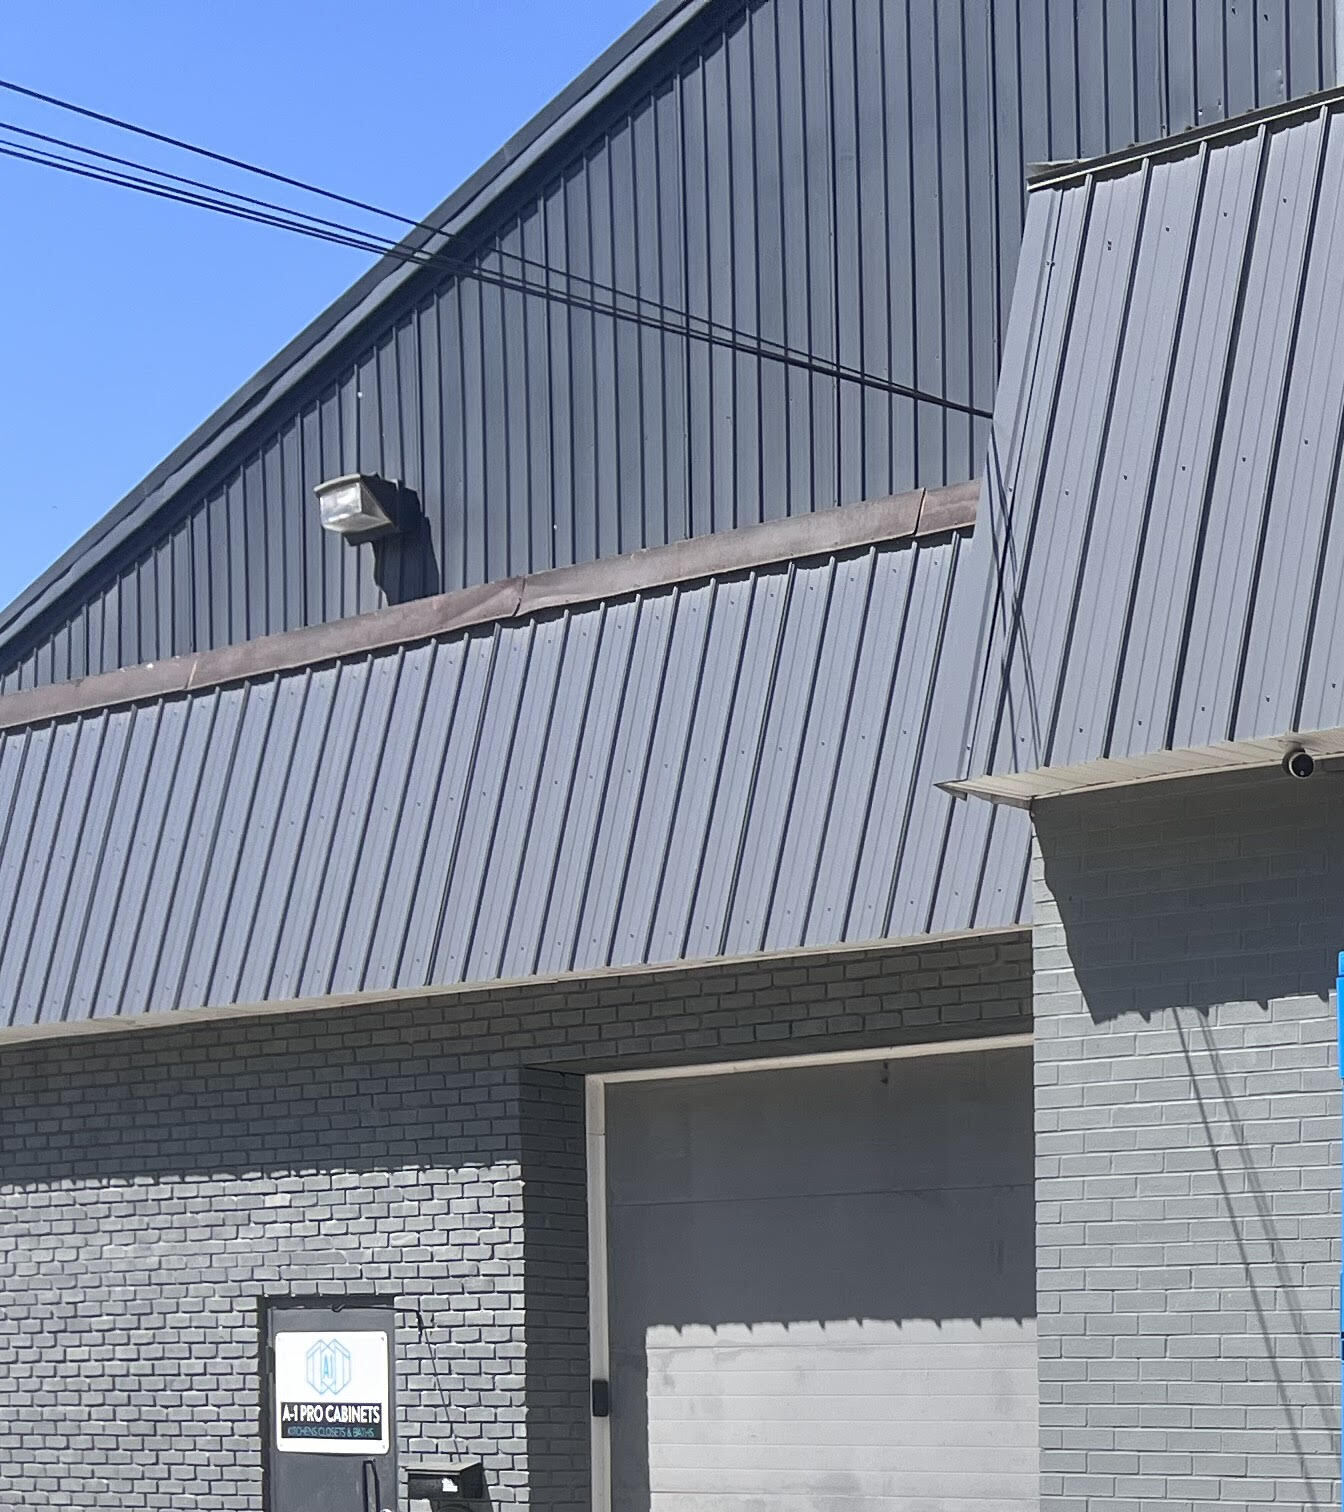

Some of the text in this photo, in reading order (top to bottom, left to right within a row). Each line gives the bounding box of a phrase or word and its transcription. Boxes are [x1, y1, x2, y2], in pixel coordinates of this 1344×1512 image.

[282, 1404, 381, 1424] A-1 PRO CABINETS
